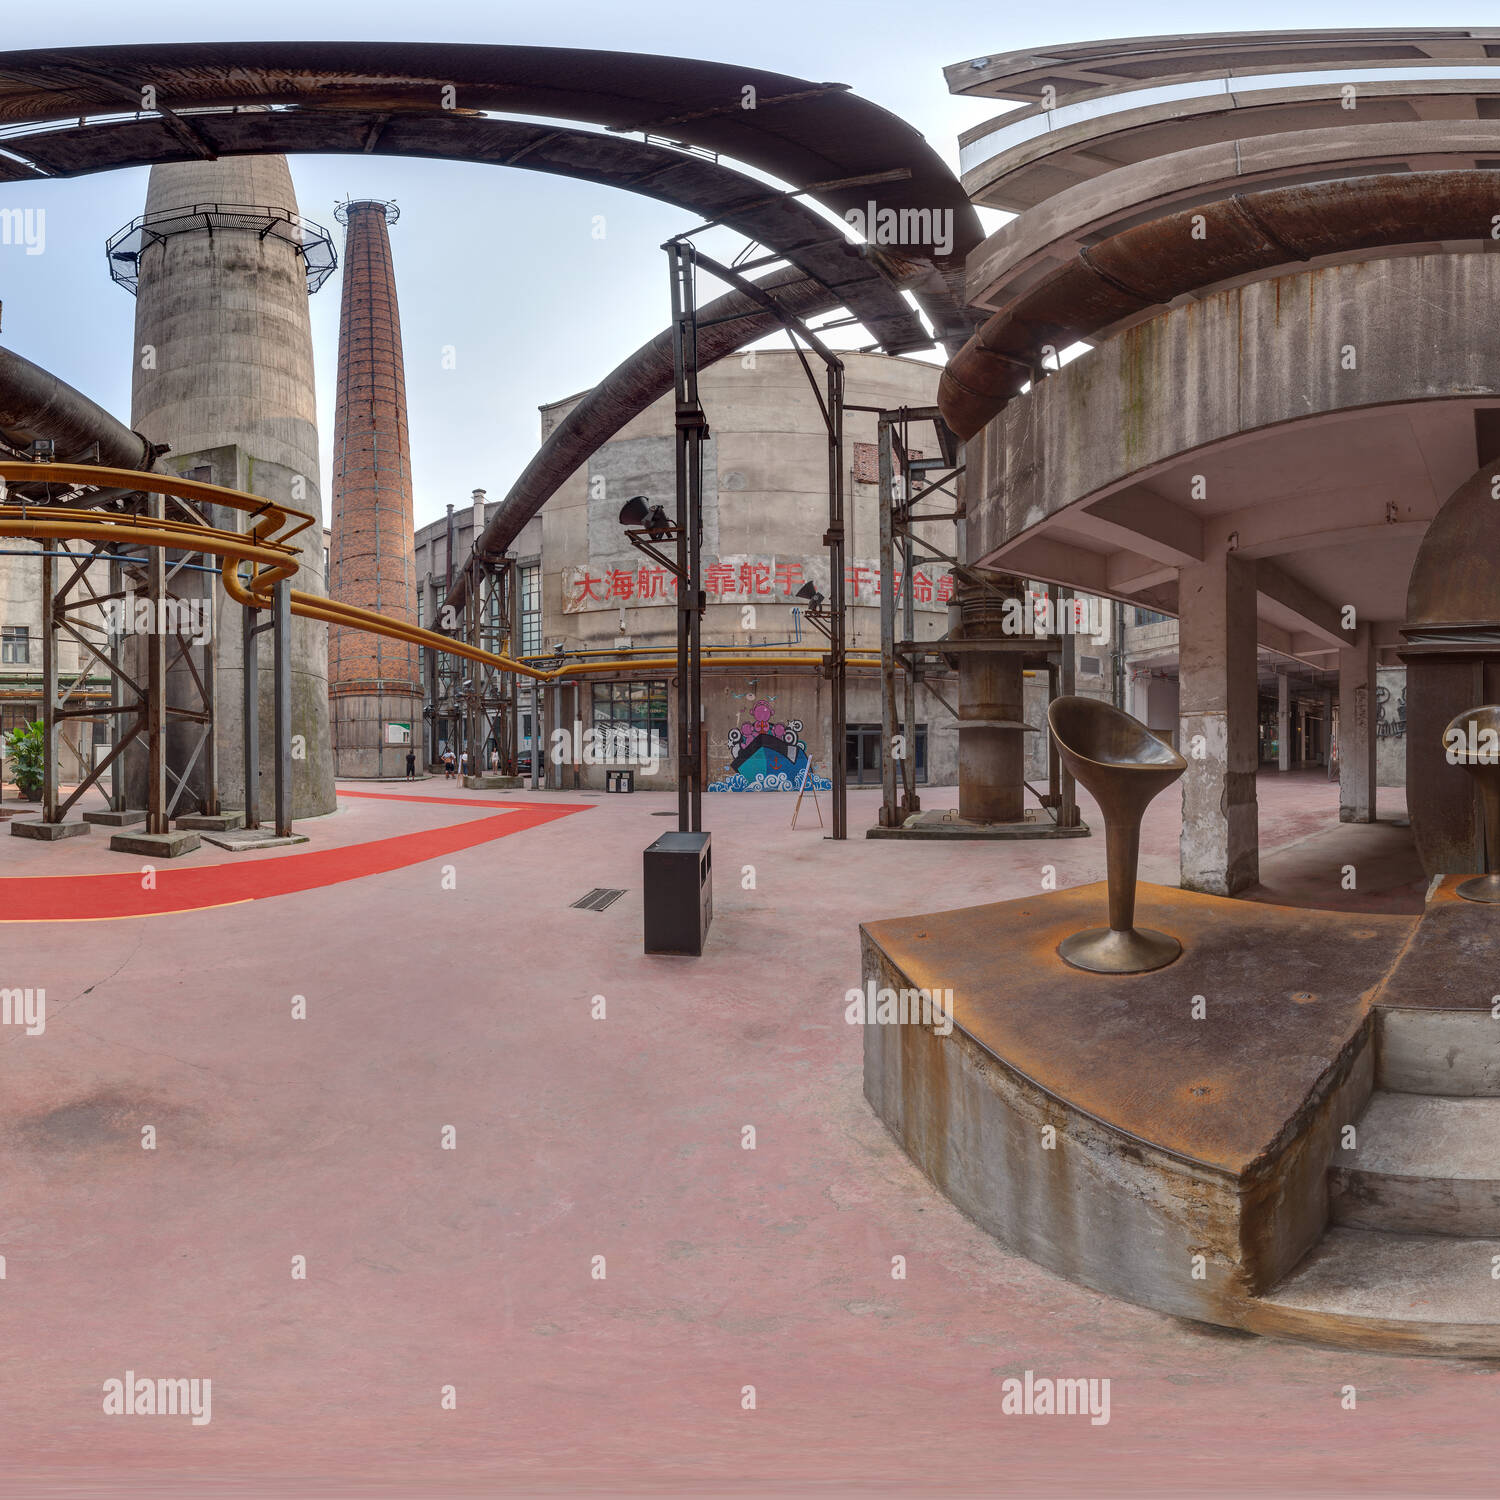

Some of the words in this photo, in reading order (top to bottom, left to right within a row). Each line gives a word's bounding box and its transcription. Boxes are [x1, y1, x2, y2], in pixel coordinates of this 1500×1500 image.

[574, 562, 806, 602] 大海航靠舵手
